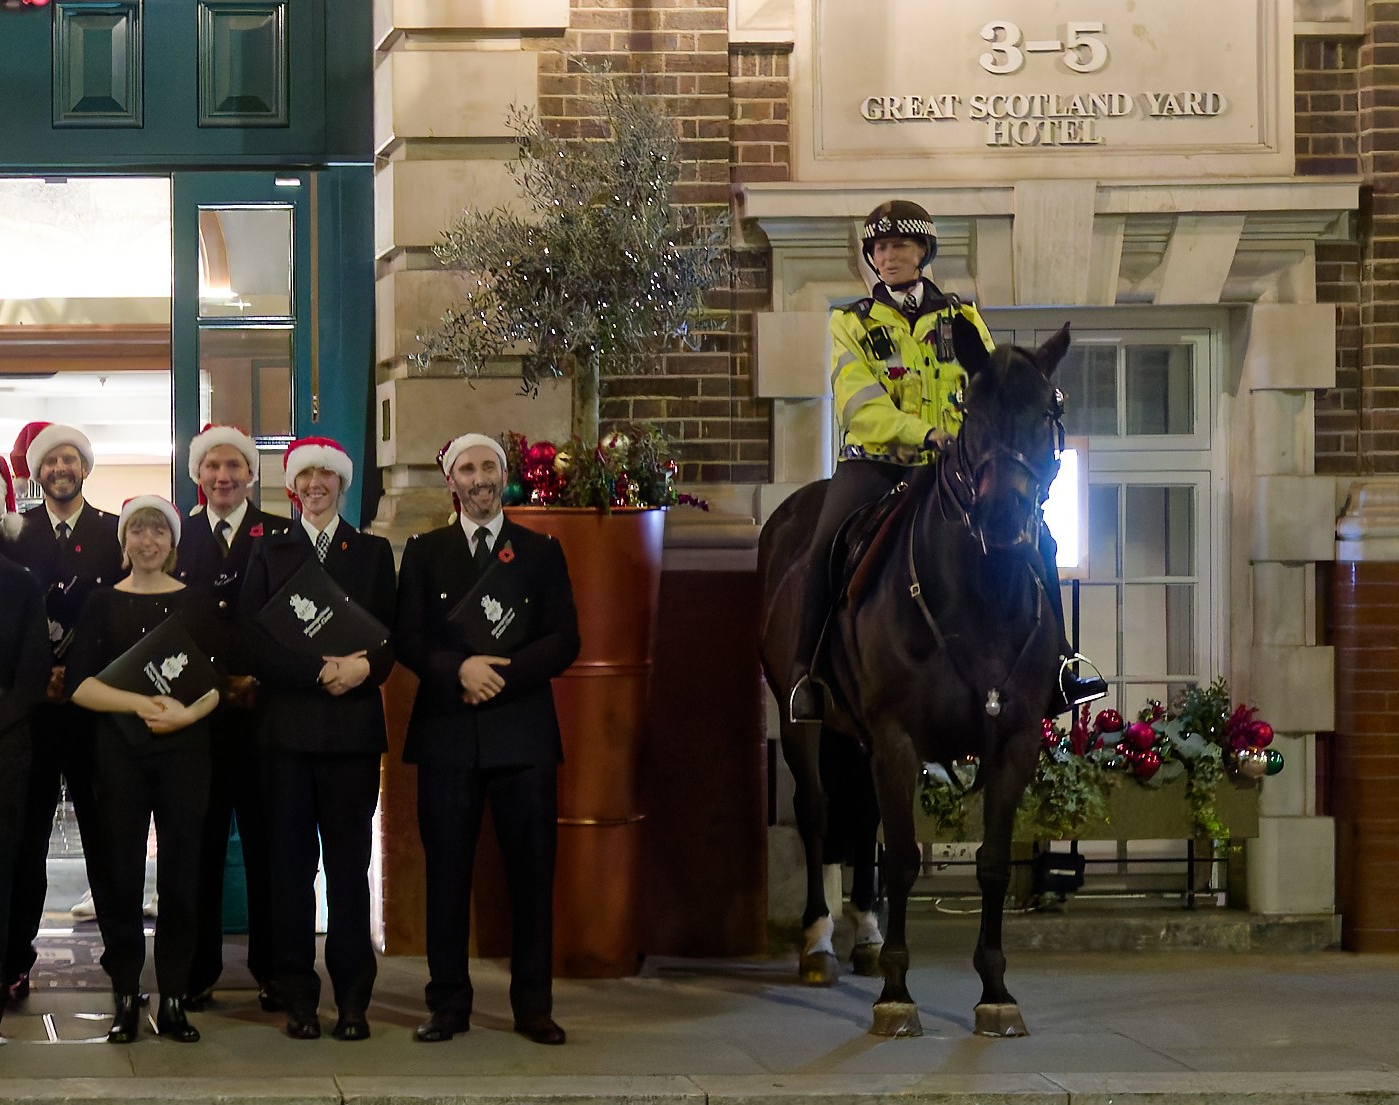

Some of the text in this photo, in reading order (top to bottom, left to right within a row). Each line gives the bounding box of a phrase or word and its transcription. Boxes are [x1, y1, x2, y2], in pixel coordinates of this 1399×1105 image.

[859, 91, 1228, 121] GREAT SCOTLAND YARD
[986, 119, 1106, 147] HOTEL
